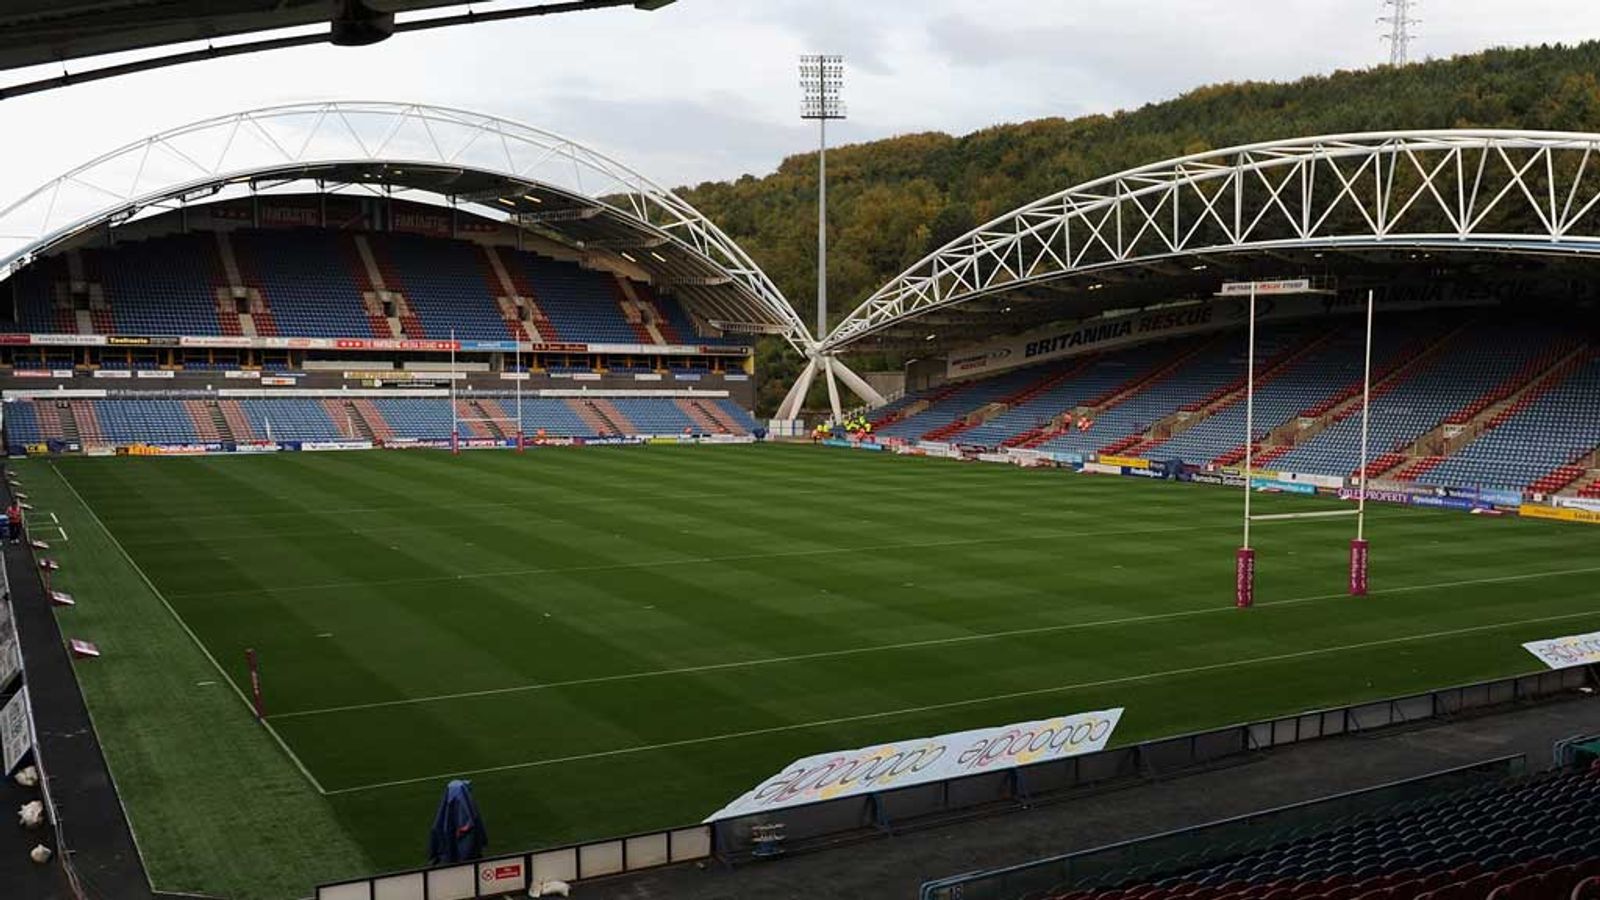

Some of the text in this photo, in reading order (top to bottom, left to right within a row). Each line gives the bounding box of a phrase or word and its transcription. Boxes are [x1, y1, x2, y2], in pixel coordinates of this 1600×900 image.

[1025, 307, 1214, 358] BRITANNIA RESCUE
[1366, 489, 1408, 503] PROPERTY
